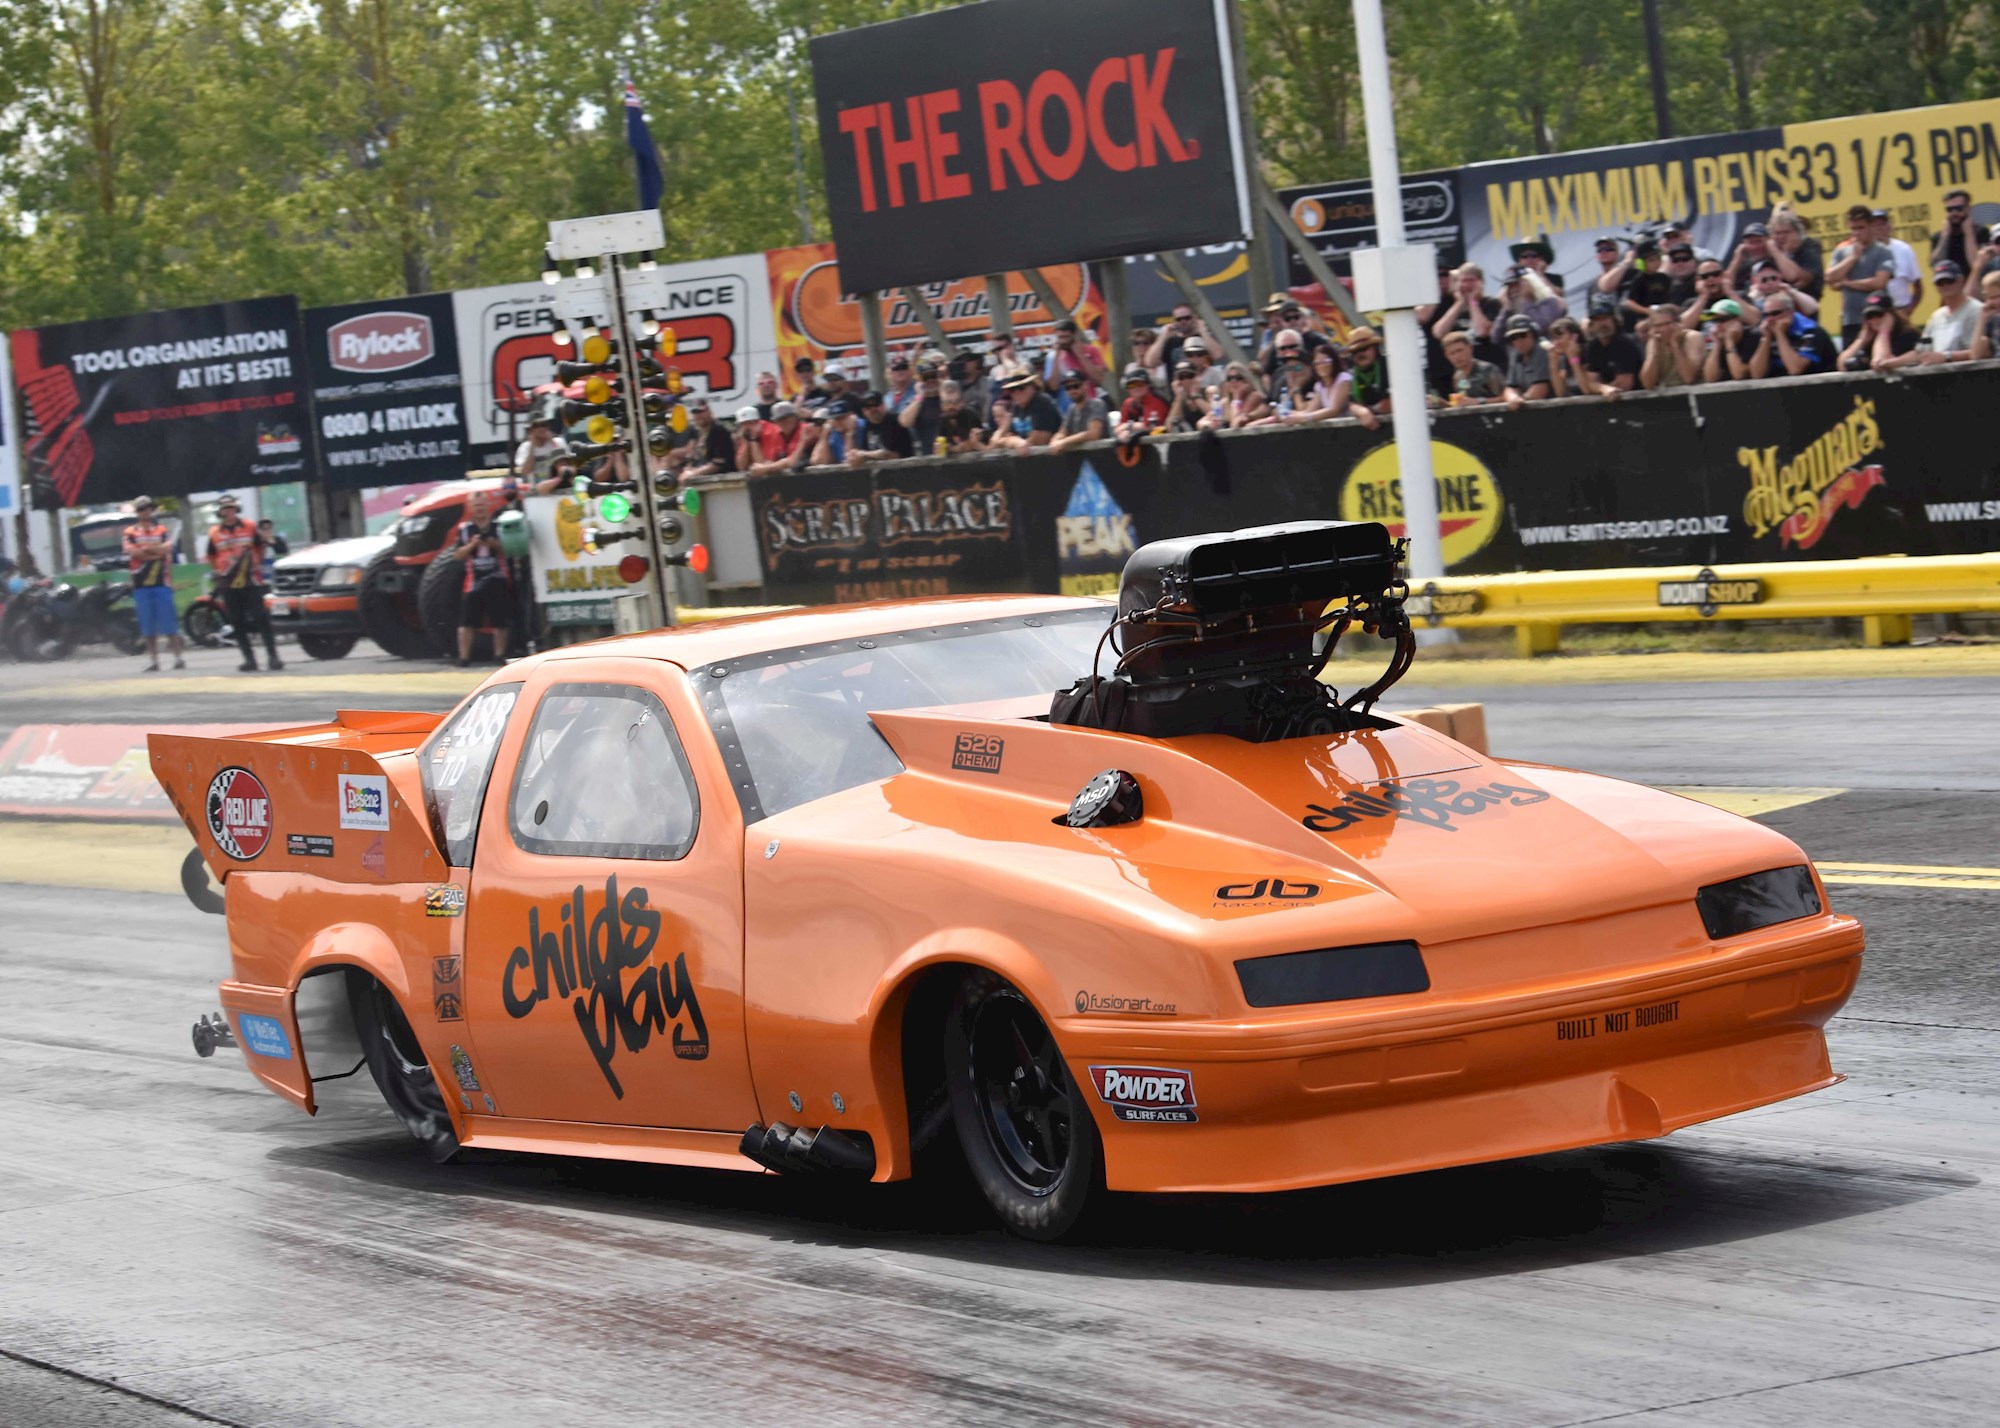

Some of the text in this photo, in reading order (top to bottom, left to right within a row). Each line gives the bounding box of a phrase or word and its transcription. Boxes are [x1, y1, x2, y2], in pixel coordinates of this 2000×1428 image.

[838, 47, 1188, 212] THE ROCK
[1486, 160, 1688, 241] MAXIMUM
[1693, 148, 1791, 216] REVS
[1789, 145, 1841, 204] 33
[1851, 132, 1919, 200] 1/3
[72, 329, 289, 374] TOOL ORGANISATION
[339, 326, 421, 363] Rylock
[176, 356, 292, 390] AT ITS BEST!
[322, 402, 459, 438] 0800 4 RYLOCK
[327, 439, 461, 467] www.rylock.co.nz
[767, 490, 1008, 549] SCRAP PALACE
[1055, 513, 1136, 558] PEAK
[834, 576, 950, 602] HAMILTON
[453, 692, 516, 748] 488
[958, 732, 1002, 755] 526
[964, 754, 998, 769] HEMI
[438, 755, 468, 787] TD
[225, 797, 245, 826] RED
[245, 798, 269, 827] LINE
[347, 788, 380, 809] Resene
[1075, 785, 1110, 807] MSD
[1302, 778, 1461, 832] childs
[1396, 782, 1550, 832] play
[1215, 878, 1322, 900] db
[503, 872, 661, 1019] childs
[1090, 994, 1177, 1012] fusionart.co.nz
[1557, 1000, 1680, 1041] BUILT NOT BOUGHT
[573, 952, 709, 1101] play
[1104, 1069, 1186, 1105] POWDER
[1126, 1109, 1188, 1121] SURFACES
